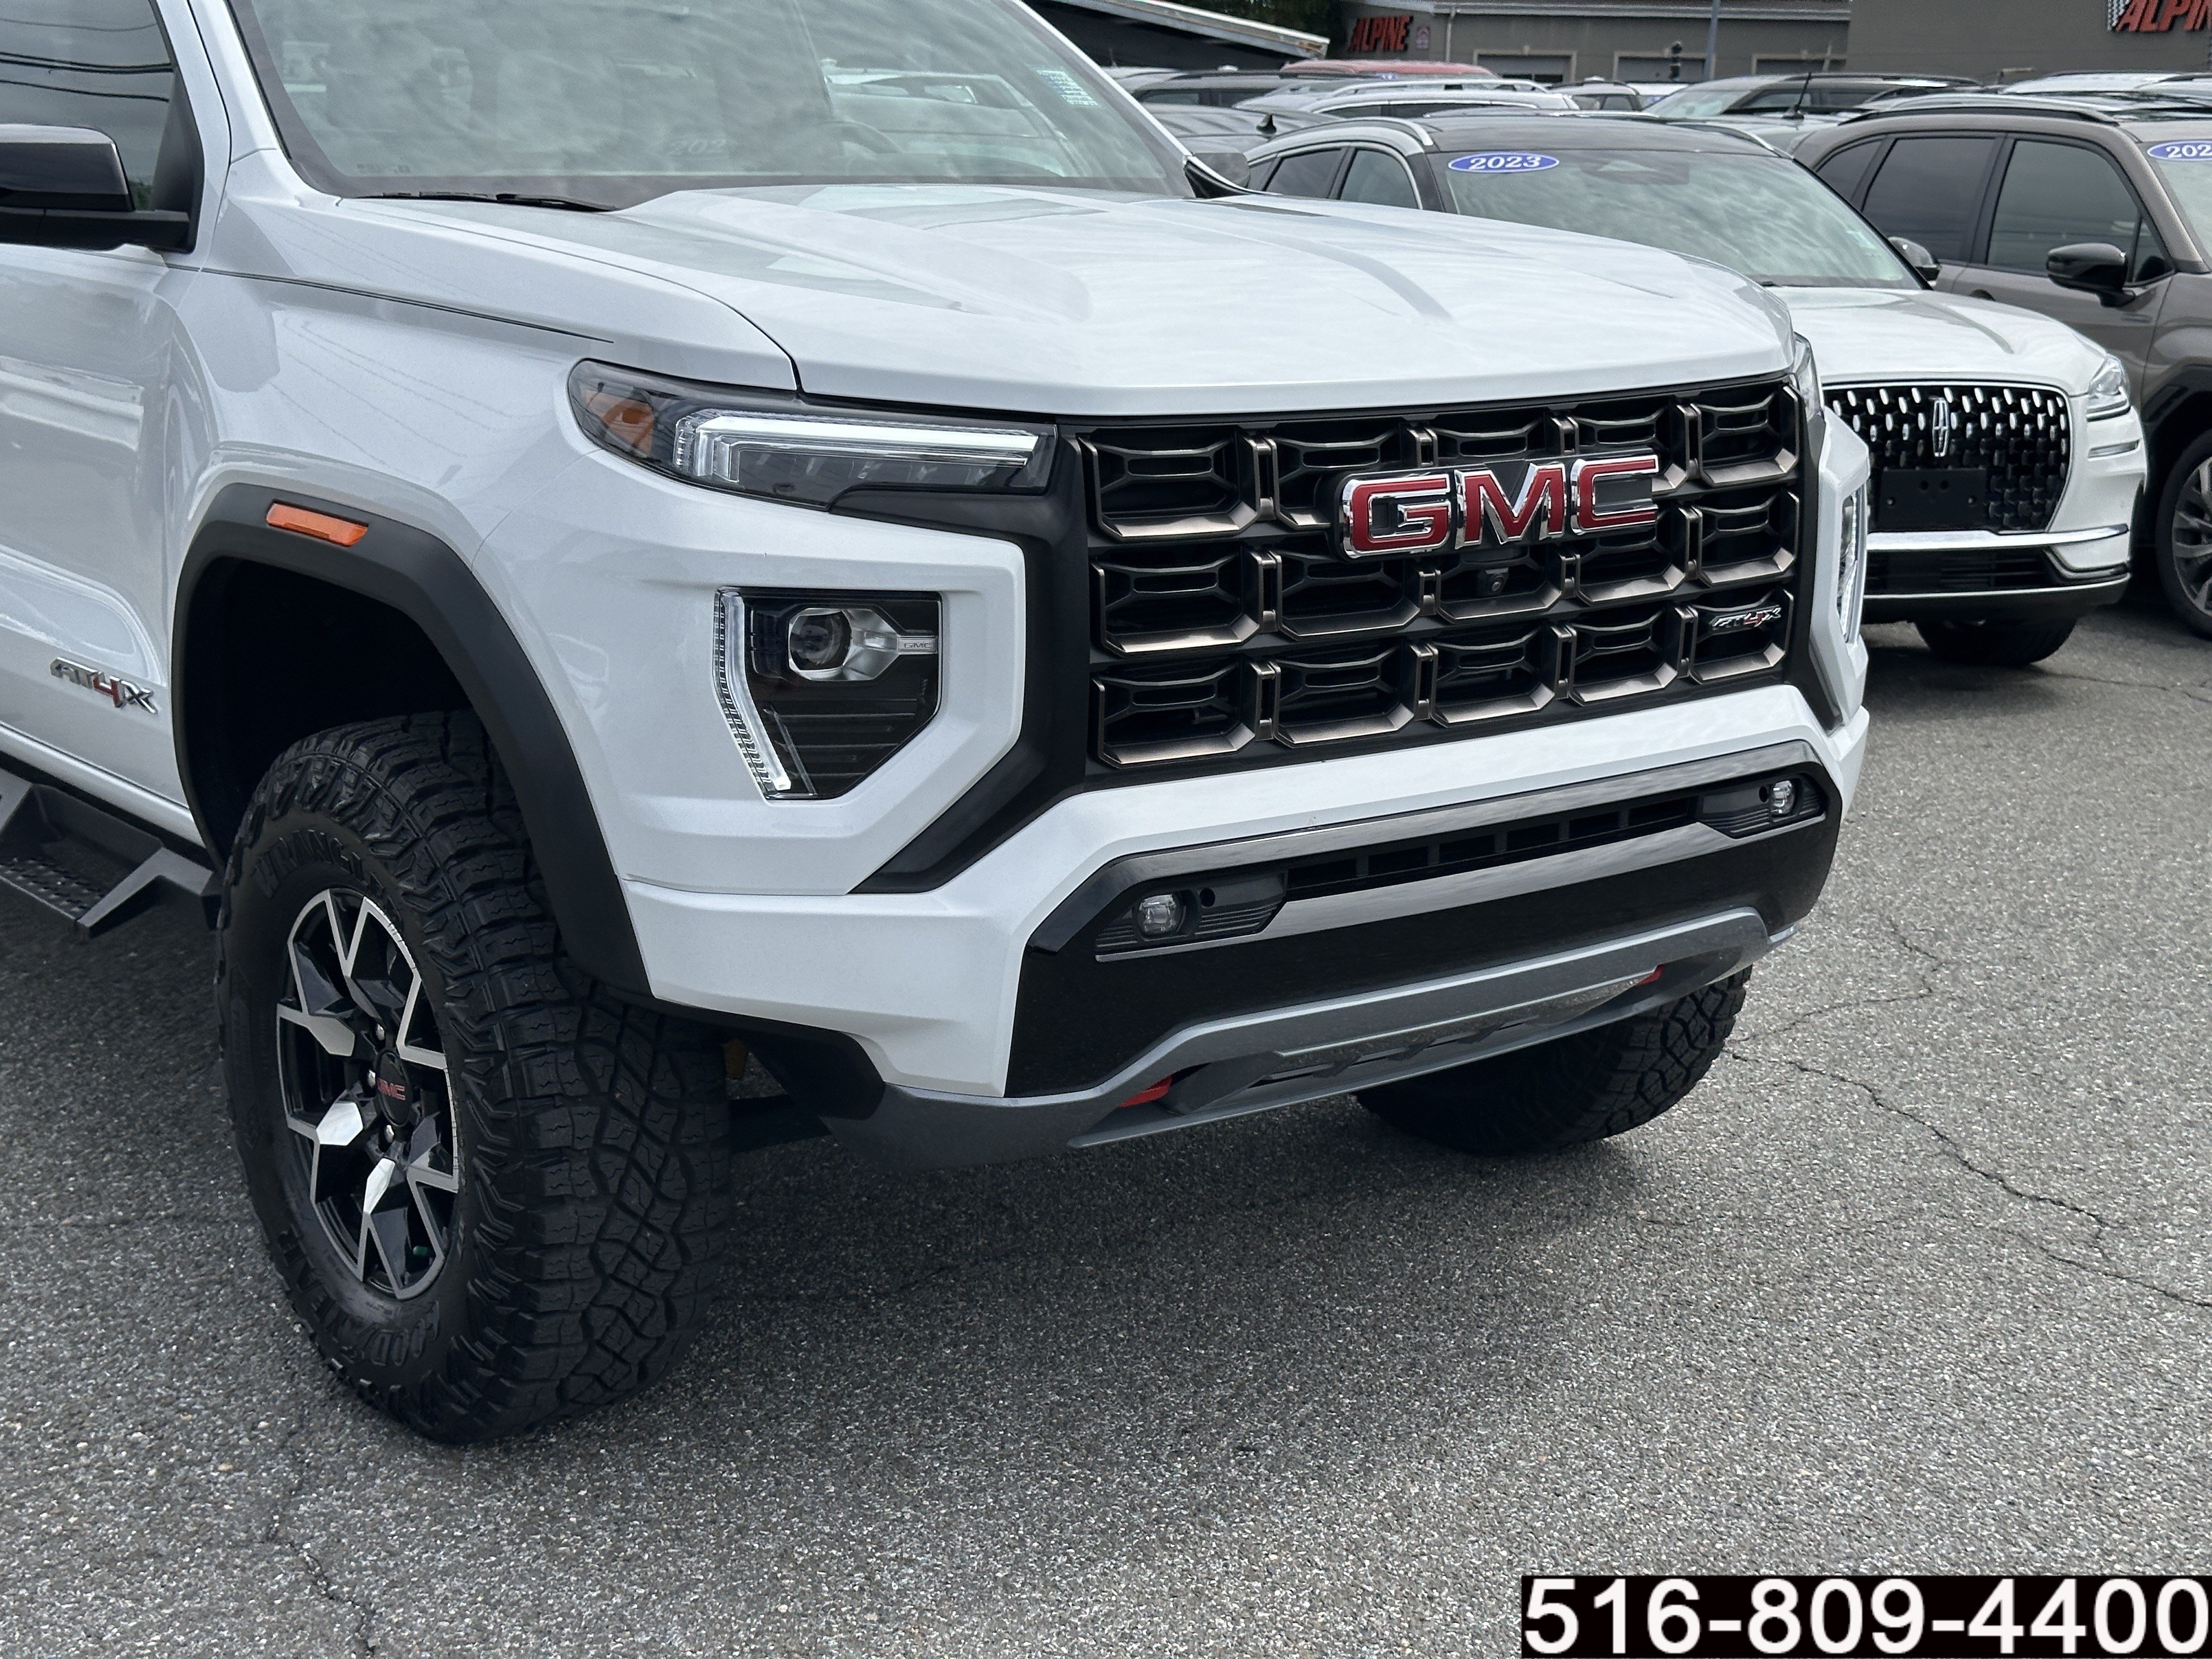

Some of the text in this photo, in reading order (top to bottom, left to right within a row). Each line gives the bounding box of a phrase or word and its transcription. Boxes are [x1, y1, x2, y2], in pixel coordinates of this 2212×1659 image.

[1350, 14, 1410, 52] ALPINE
[1468, 155, 1541, 171] 2023
[1342, 455, 1659, 559] GMC
[50, 657, 158, 714] AT4X
[377, 1077, 405, 1101] GMC
